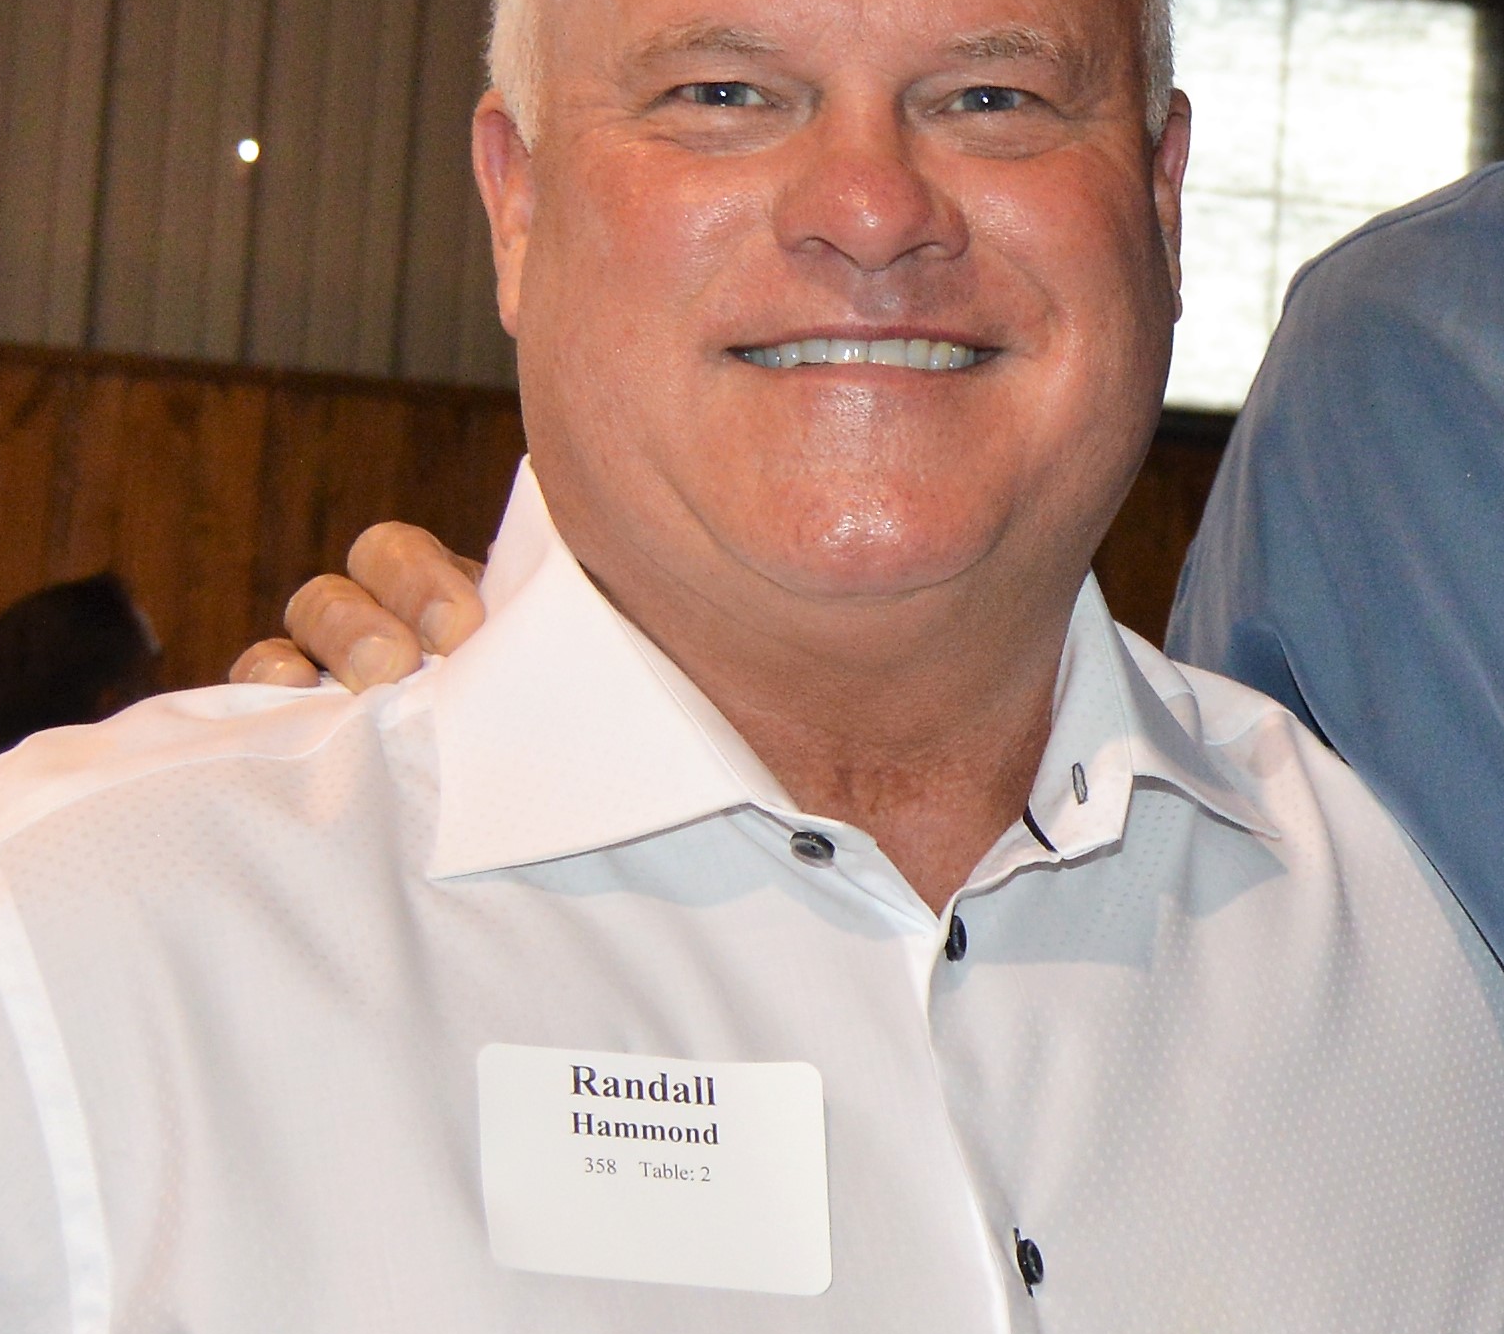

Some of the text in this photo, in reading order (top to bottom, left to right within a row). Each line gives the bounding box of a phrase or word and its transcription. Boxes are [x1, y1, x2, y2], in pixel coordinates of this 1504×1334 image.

[570, 1064, 717, 1106] Randall
[572, 1112, 720, 1145] Hammond
[584, 1157, 711, 1182] 358 Table: 2
